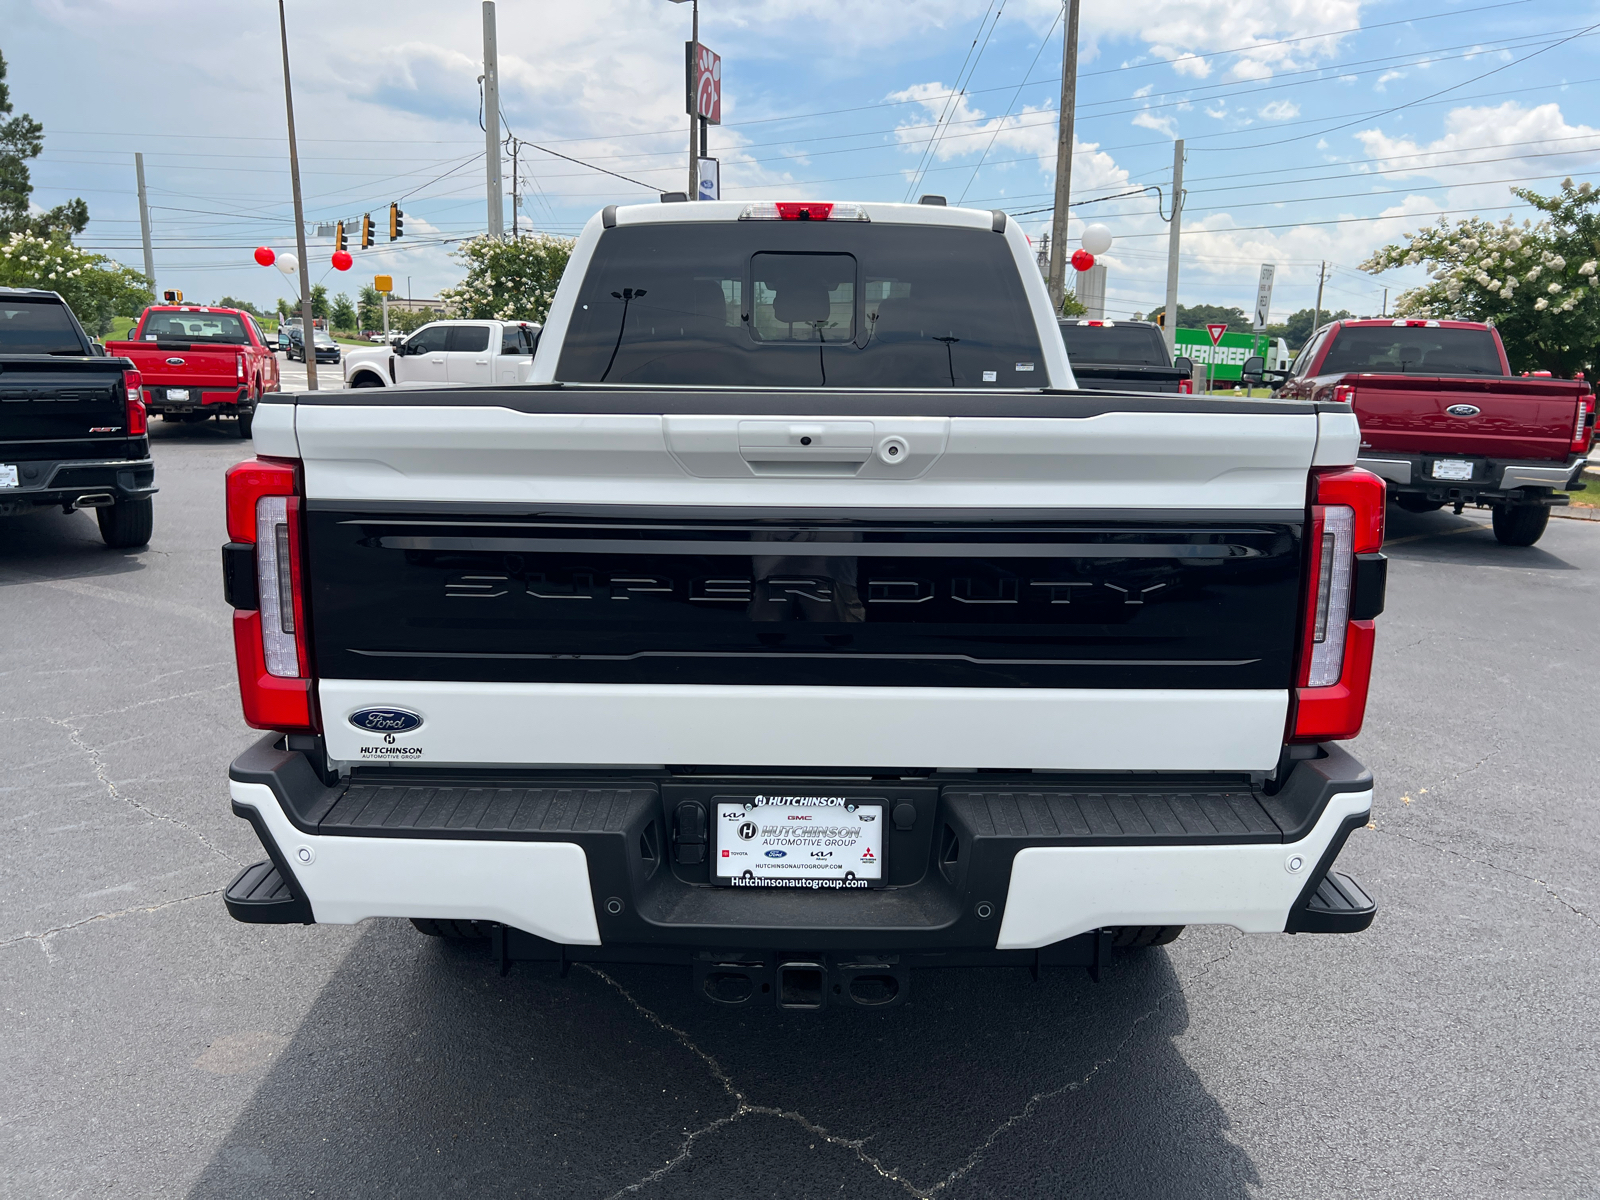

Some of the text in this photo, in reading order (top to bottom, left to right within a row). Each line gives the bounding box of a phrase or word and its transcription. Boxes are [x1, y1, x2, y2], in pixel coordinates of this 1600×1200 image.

[444, 573, 1170, 604] SUPER DUTY
[365, 712, 406, 729] Ford
[360, 746, 423, 755] HUTCHINSON
[768, 796, 846, 807] HUTCHINSON
[760, 825, 862, 839] HUTCHINSON
[762, 838, 857, 847] AUTOMOTIVE GROUP
[731, 876, 868, 889] Hutchinsonautogroup.com
